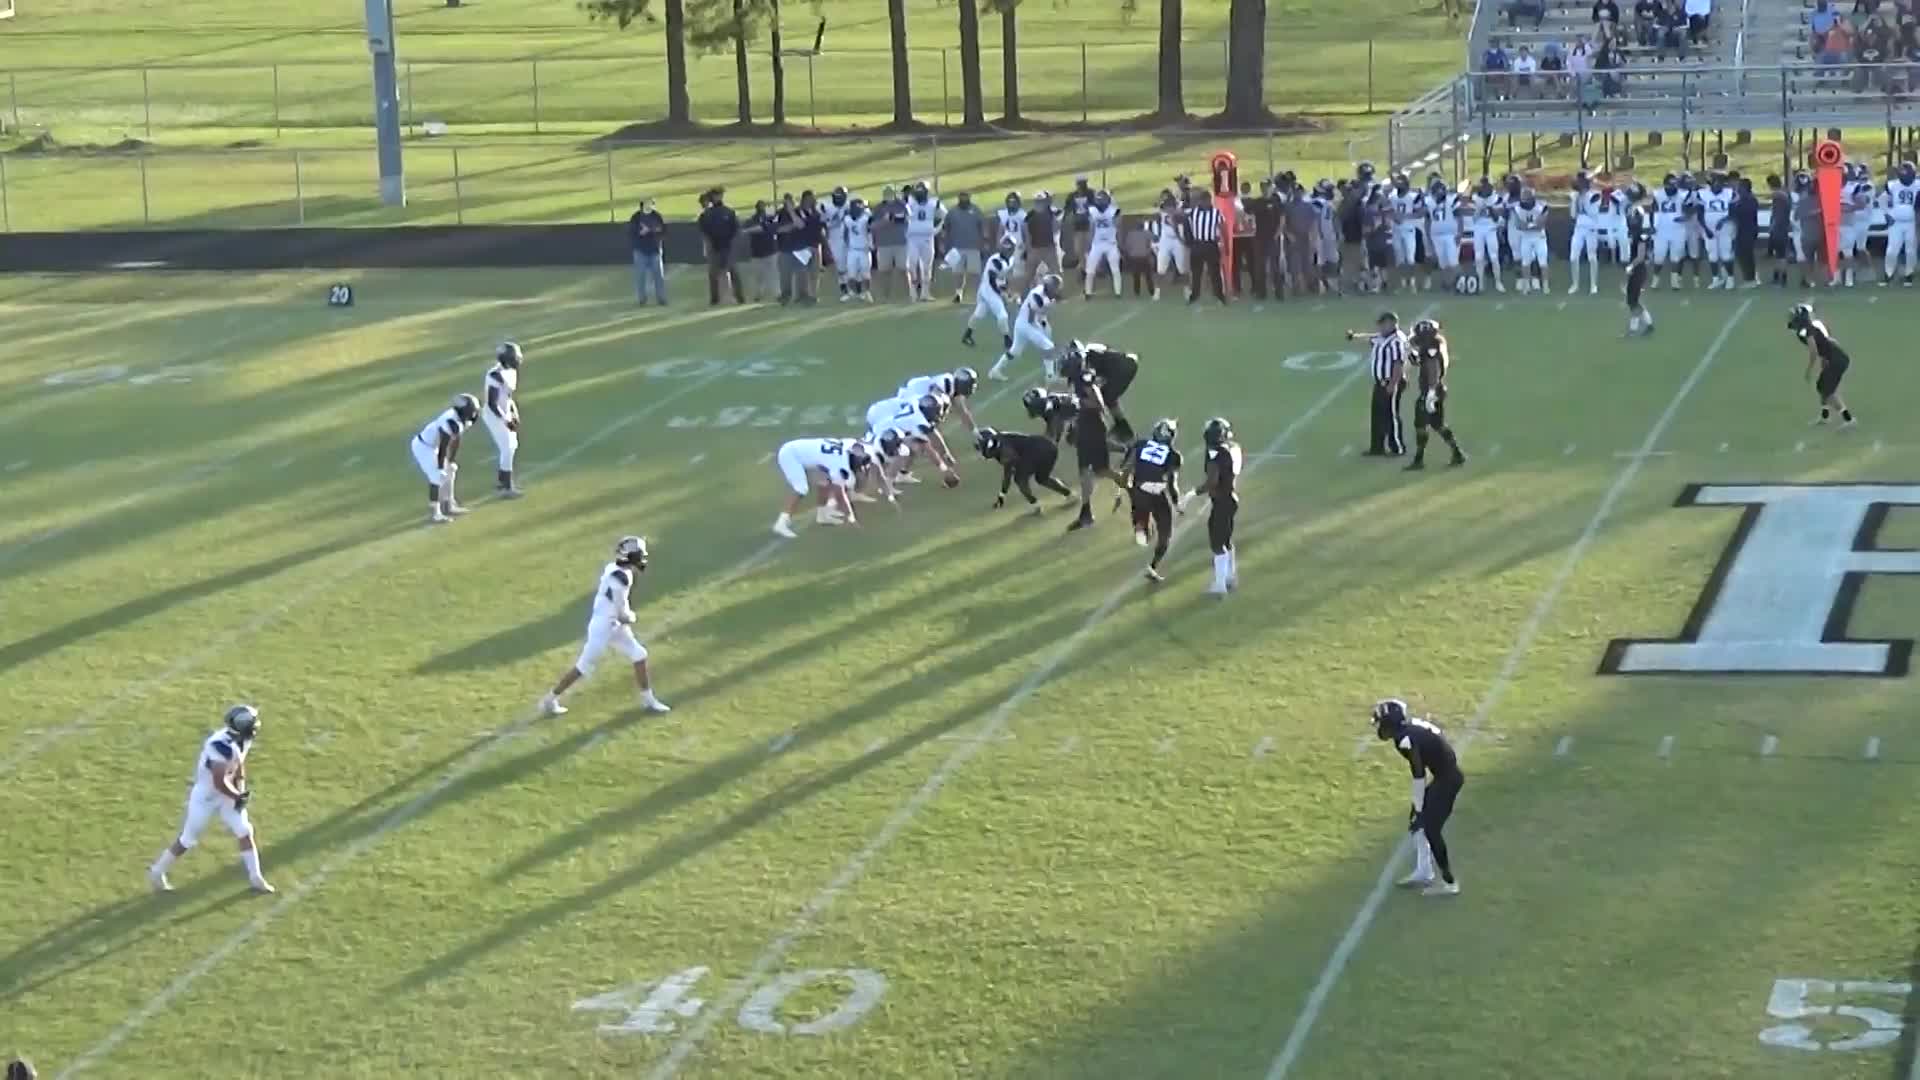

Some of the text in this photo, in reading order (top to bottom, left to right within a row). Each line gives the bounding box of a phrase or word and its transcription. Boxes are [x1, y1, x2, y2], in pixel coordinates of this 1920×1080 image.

[331, 286, 349, 304] 20
[1456, 275, 1478, 294] 40
[570, 965, 887, 1036] 40
[1758, 978, 1913, 1051] 5
